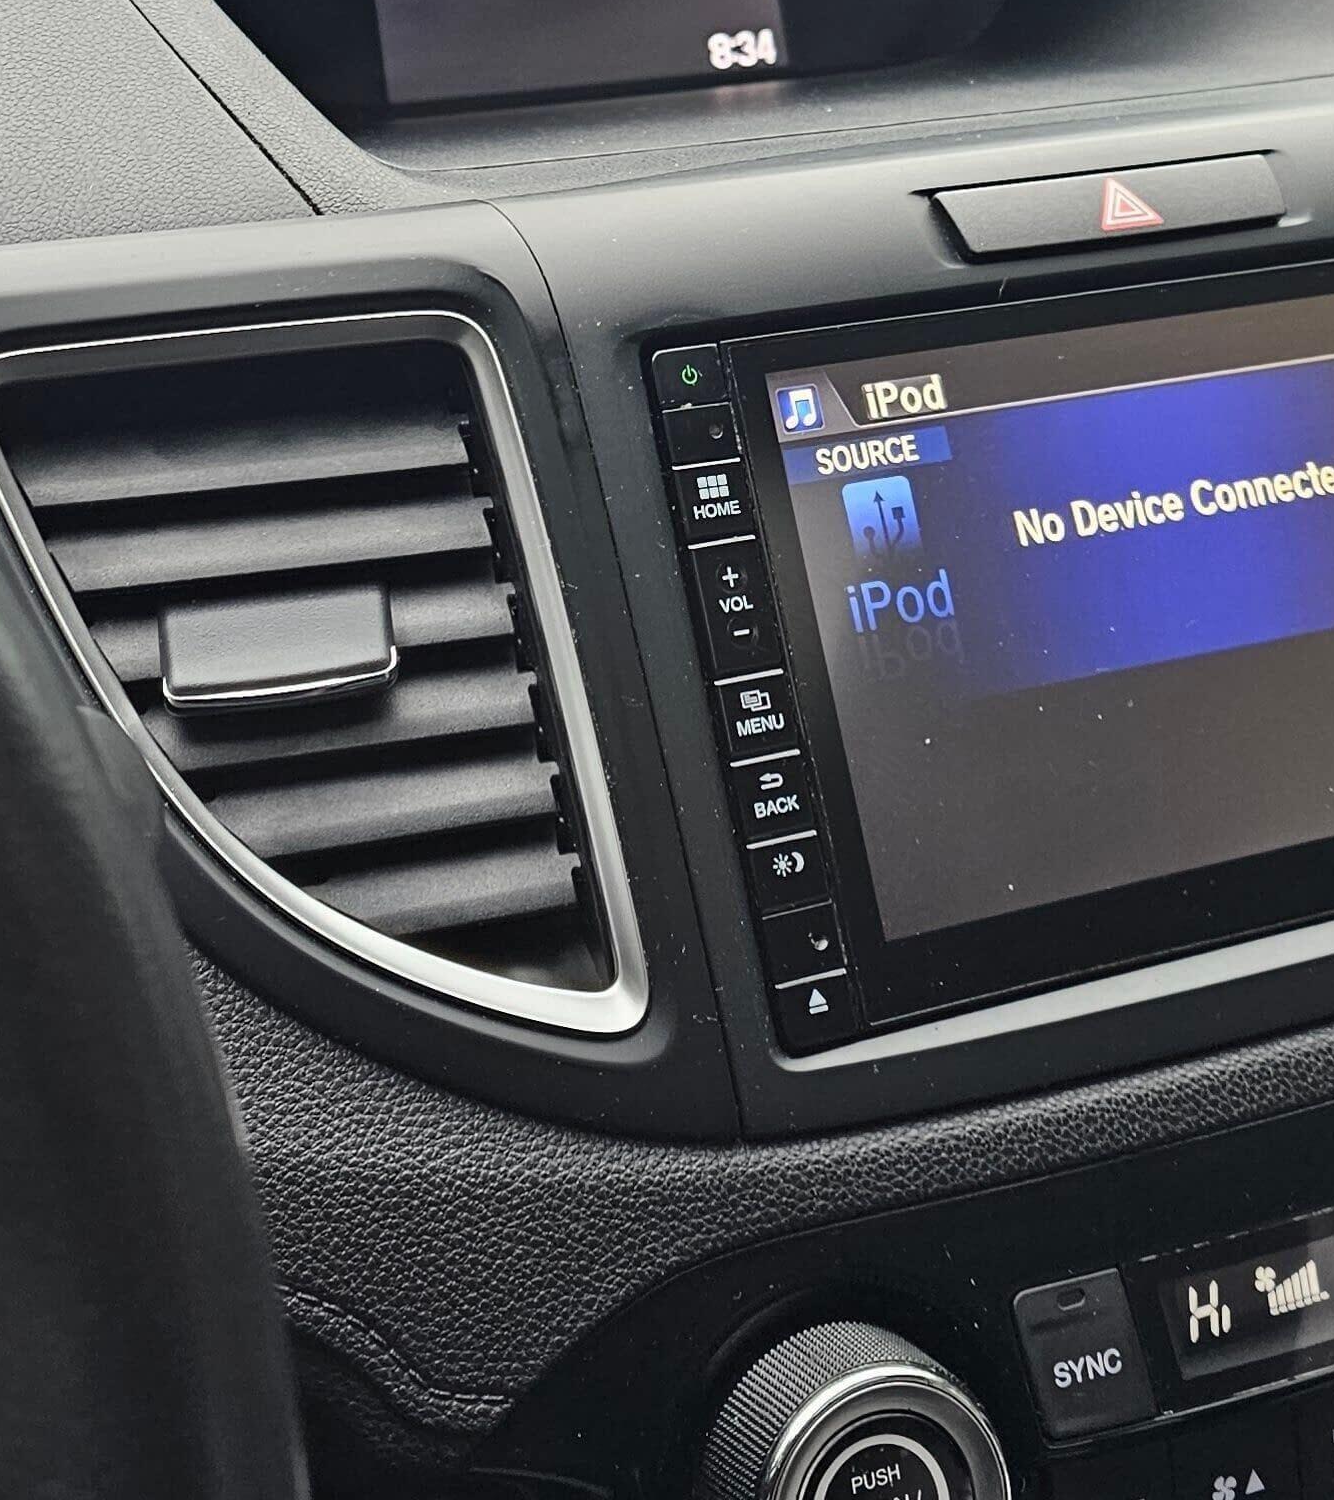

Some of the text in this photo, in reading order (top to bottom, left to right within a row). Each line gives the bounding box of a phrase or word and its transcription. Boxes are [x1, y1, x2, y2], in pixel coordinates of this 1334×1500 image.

[864, 373, 947, 421] iPod
[815, 434, 920, 475] SOURCE
[693, 500, 741, 520] HOME
[1013, 509, 1065, 547] No
[1070, 491, 1184, 538] Device
[719, 594, 754, 614] VOL
[845, 568, 956, 633] iPod
[736, 713, 785, 738] MENU
[753, 795, 800, 820] BACK
[1054, 1348, 1123, 1389] SYNC
[851, 1463, 901, 1495] PUSH
